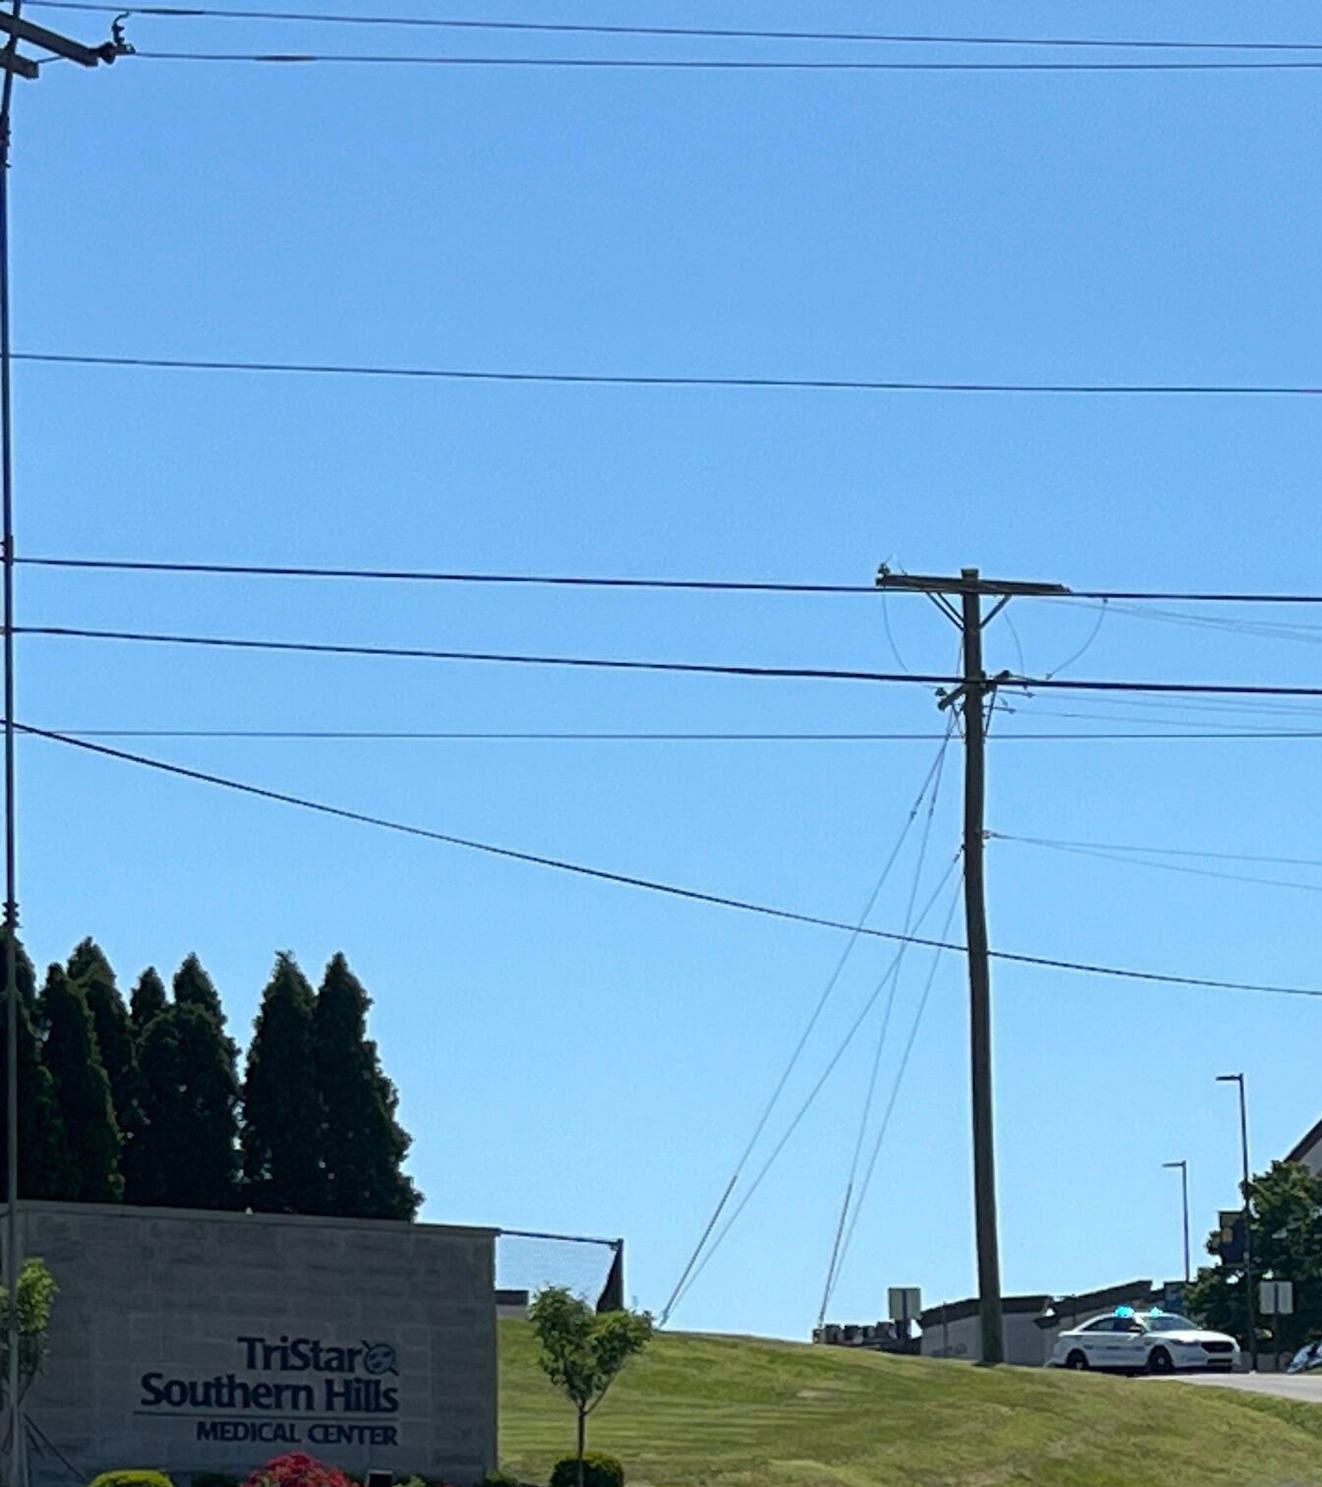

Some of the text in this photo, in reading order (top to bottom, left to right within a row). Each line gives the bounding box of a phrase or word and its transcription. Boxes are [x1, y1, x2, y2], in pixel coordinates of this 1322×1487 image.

[237, 1336, 362, 1373] TriStar
[140, 1372, 399, 1413] Southern Hills
[196, 1421, 398, 1446] MEDICAL CENTER
